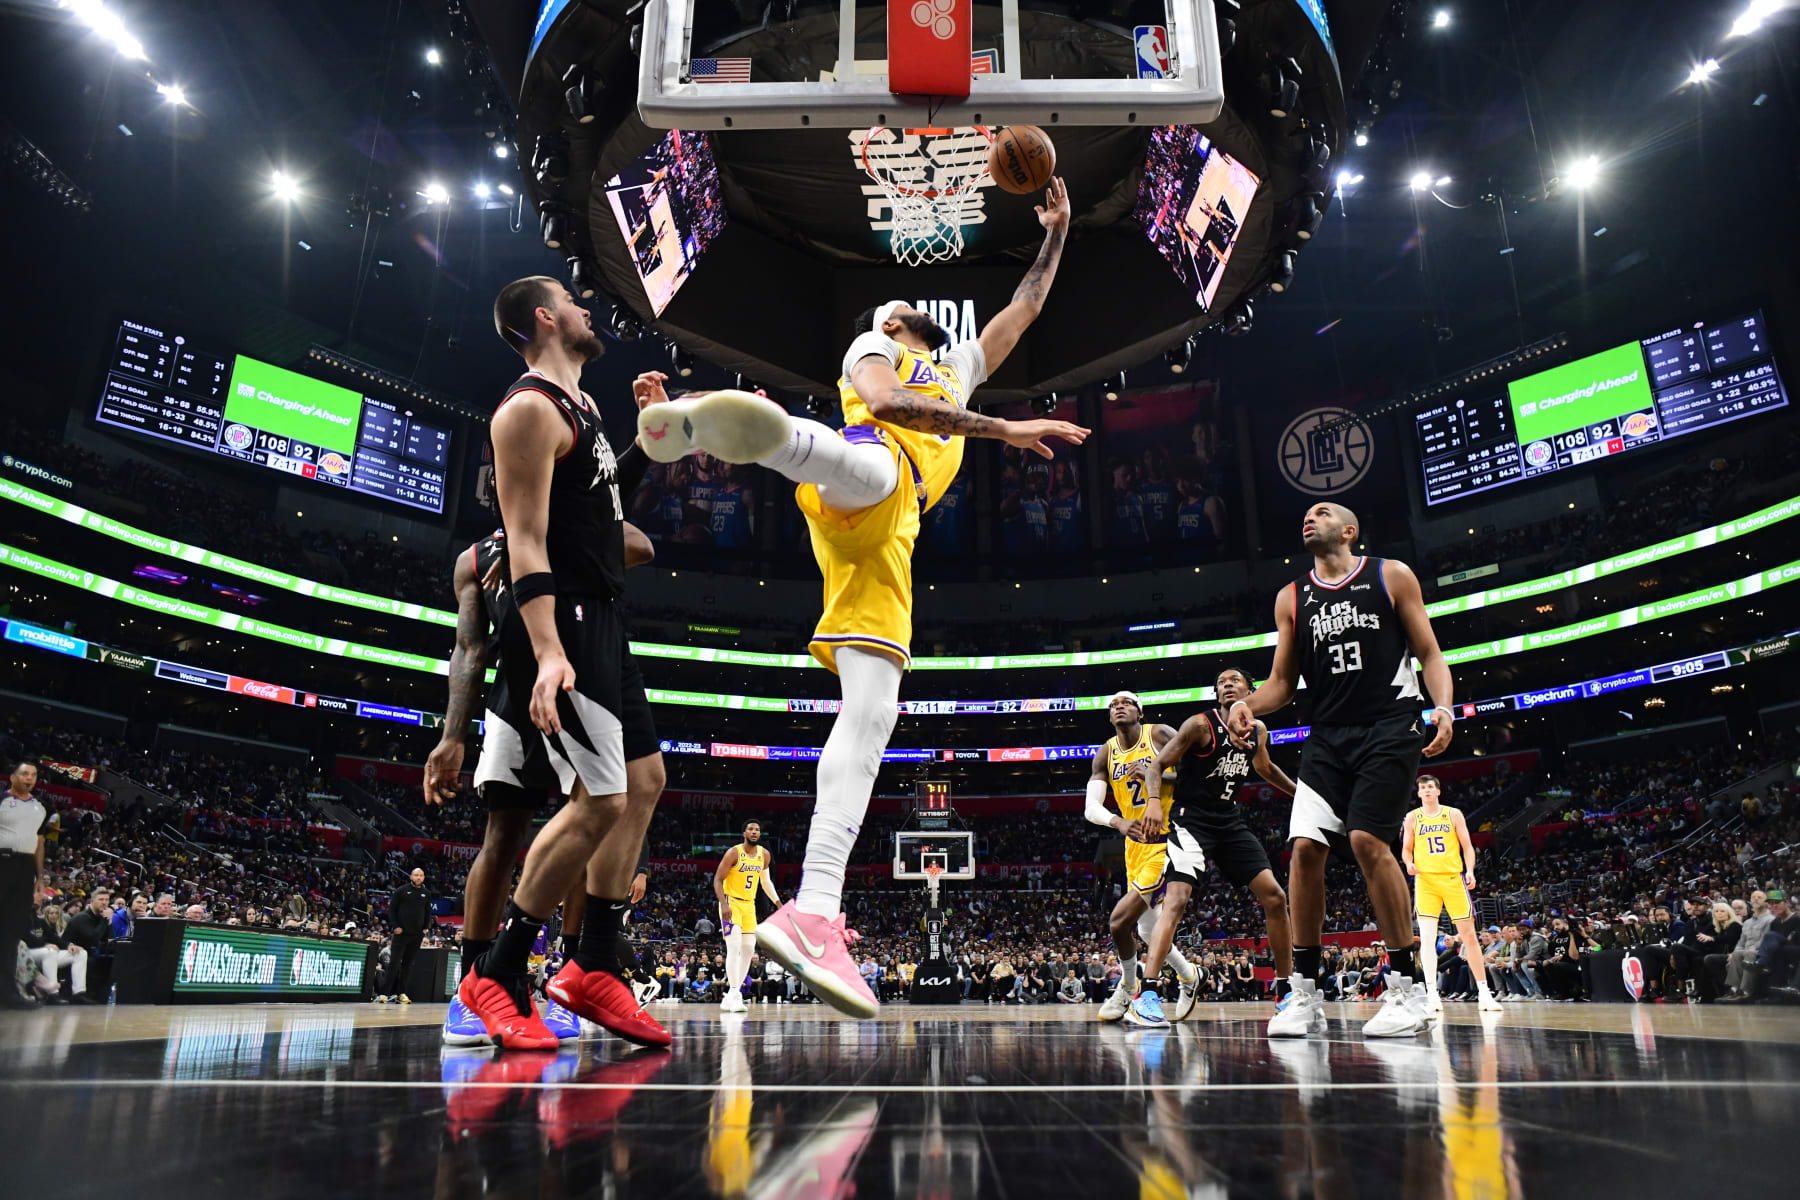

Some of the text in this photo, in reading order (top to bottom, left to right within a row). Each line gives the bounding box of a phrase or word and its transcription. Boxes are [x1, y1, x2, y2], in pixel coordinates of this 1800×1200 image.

[122, 320, 164, 338] TEAM STATS
[1743, 318, 1756, 328] 22
[1642, 329, 1682, 346] TEAM STATS
[1683, 338, 1694, 347] 36
[1749, 332, 1756, 340] 0
[158, 344, 170, 353] 33
[214, 362, 225, 370] 21
[1689, 364, 1700, 372] 29
[1744, 365, 1772, 378] 48.6%
[152, 370, 164, 379] 31
[1538, 386, 1594, 410] Charging
[1596, 370, 1638, 392] Ahead
[1748, 378, 1776, 392] 40.9%
[256, 390, 311, 416] Charging
[312, 408, 352, 426] Ahead
[364, 397, 380, 406] TEAM
[1494, 400, 1503, 408] 21
[1718, 402, 1744, 414] 11-18
[1751, 392, 1780, 406] 61.1%
[162, 408, 186, 421] 16-33
[196, 405, 220, 418] 55.9%
[190, 431, 215, 444] 84.2%
[1452, 438, 1461, 446] 31
[1556, 424, 1614, 450] 108 92
[259, 434, 314, 460] 108 92
[1577, 446, 1602, 460] 7:11
[255, 454, 266, 462] 4th
[272, 456, 297, 472] 7:11
[14, 460, 72, 488] crypto.com
[714, 516, 726, 532] 23
[103, 521, 167, 550] ladwp.com/ev
[1615, 540, 1686, 568] Charging Ahead
[10, 552, 80, 582] ladwp.com/ev
[224, 560, 264, 580] Charging
[1502, 579, 1562, 598] ladwp.com/ev
[136, 593, 208, 618] Charging Ahead
[332, 589, 389, 610] ladwp.com/ev
[1657, 590, 1724, 613] ladwp.com/ev
[1319, 600, 1351, 620] Los
[256, 624, 312, 646] ladwp.com/ev
[1309, 606, 1380, 652] Angeles
[1543, 618, 1608, 643] Charging Ahead
[20, 628, 76, 650] mobilitie
[364, 648, 400, 663] Charging
[730, 654, 779, 664] ladwp.com/ev
[1328, 641, 1362, 674] 33
[1672, 660, 1704, 676] 9:05
[179, 672, 207, 684] Welcome
[1602, 674, 1644, 688] crypto.com
[318, 699, 348, 710] TOYOTA
[665, 694, 715, 704] ladwp.com/ev
[1523, 688, 1574, 706] Spectrum
[362, 706, 418, 720] AMERICAN EXPRESS
[912, 702, 938, 712] 7:11
[1002, 702, 1016, 712] 92
[1476, 702, 1505, 712] TOYOTA
[714, 746, 765, 757] TOSHIBA
[1060, 748, 1097, 757] DELTA
[927, 784, 947, 793] 7:11
[1126, 779, 1146, 809] 2
[1220, 782, 1235, 800] 5
[930, 794, 944, 809] 11
[1419, 824, 1450, 836] LAKERS
[1427, 836, 1446, 854] 15
[738, 863, 762, 873] LAKERS
[745, 875, 754, 890] 5
[192, 941, 278, 985] NBAStore.com
[300, 948, 362, 986] NBAStore.com
